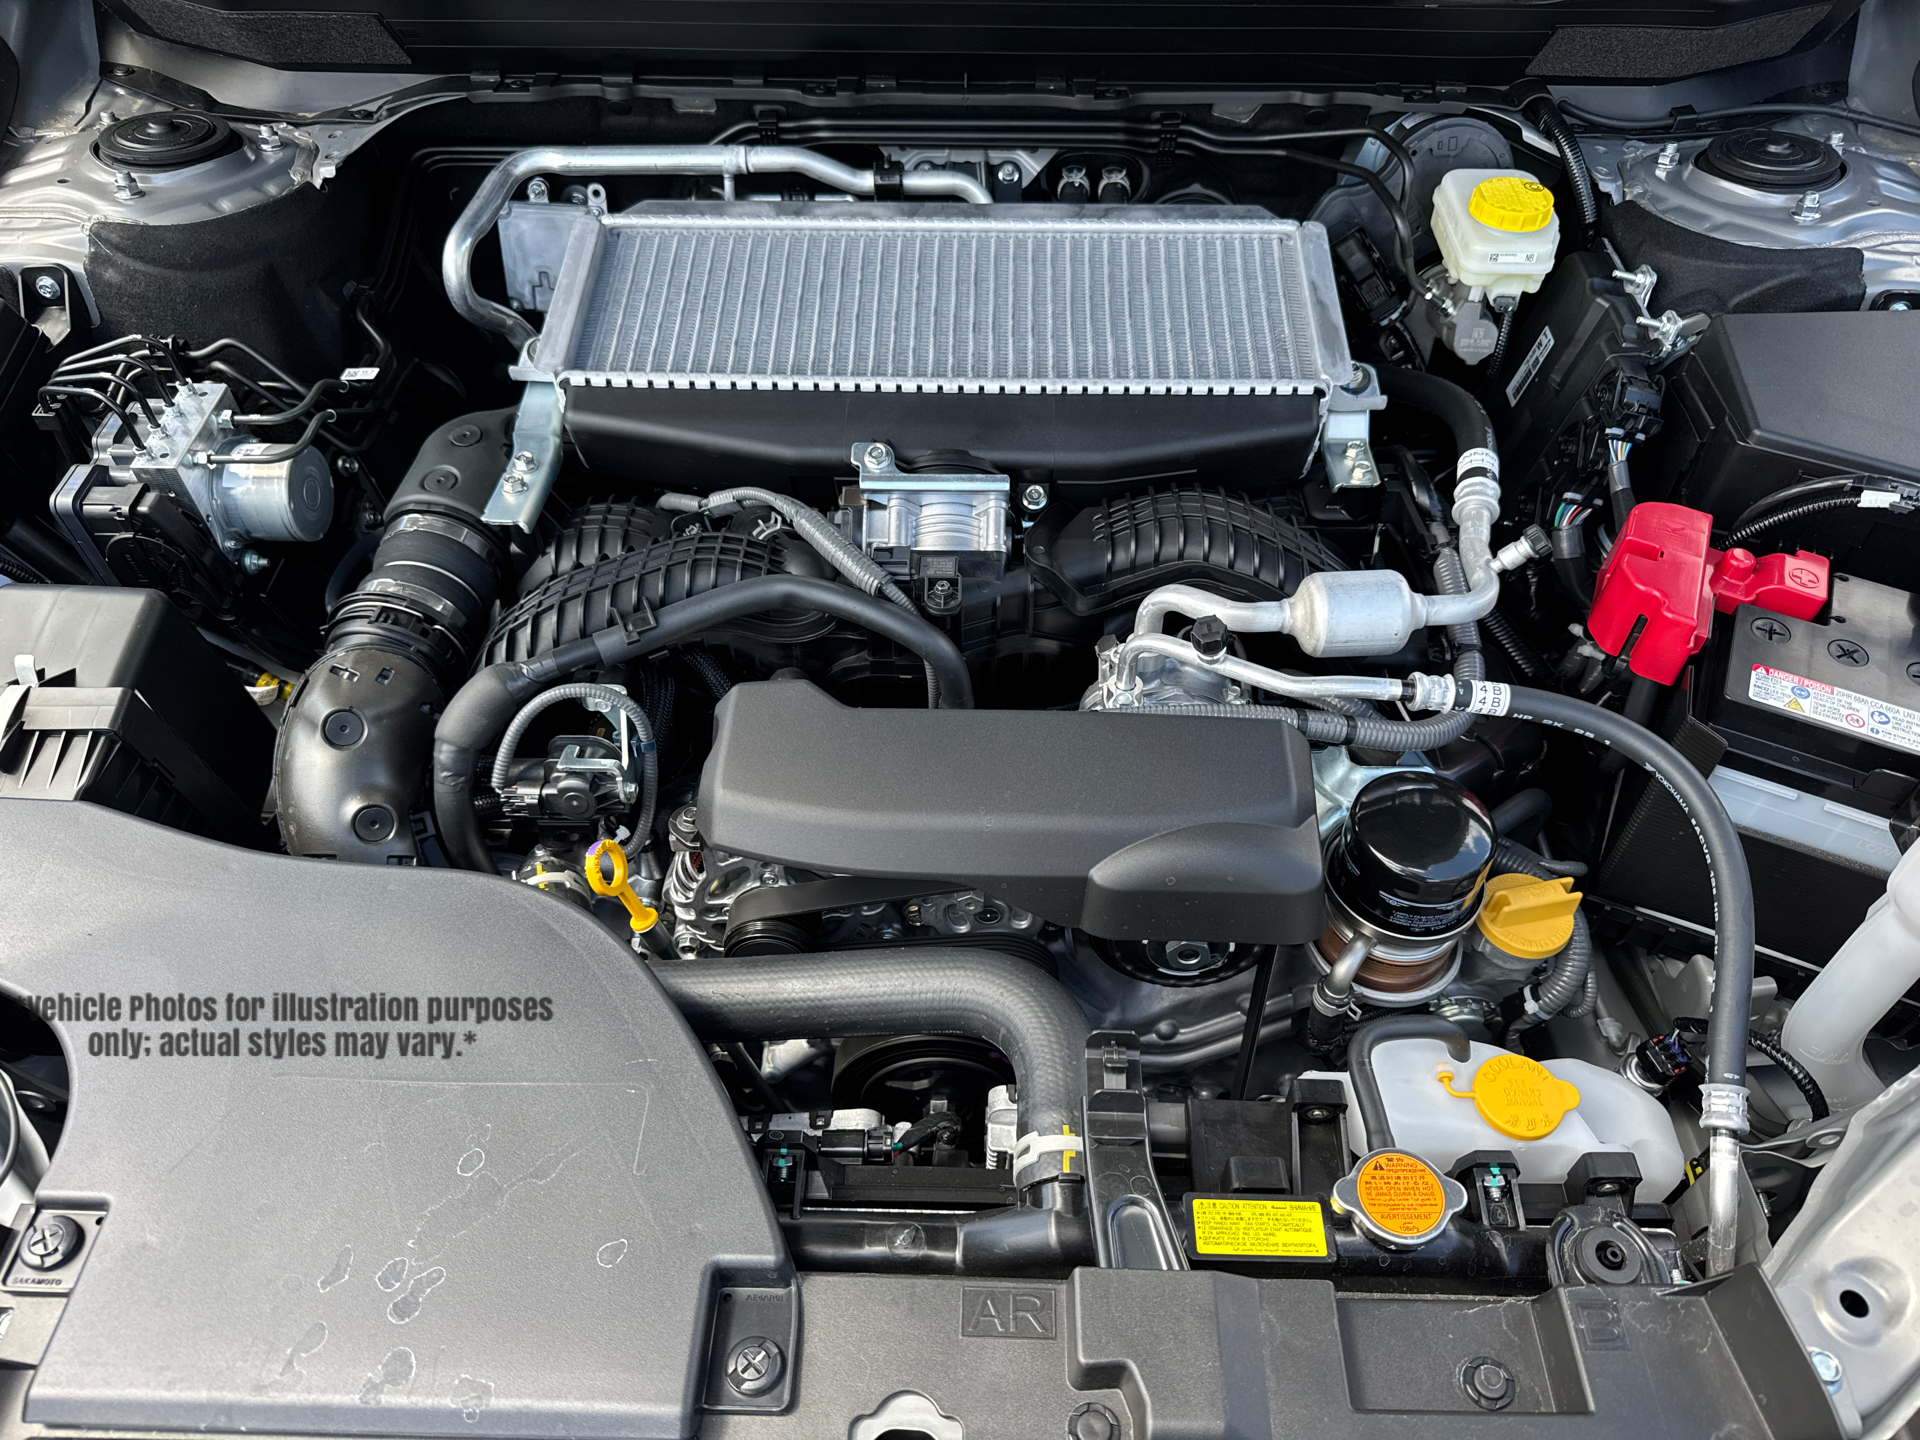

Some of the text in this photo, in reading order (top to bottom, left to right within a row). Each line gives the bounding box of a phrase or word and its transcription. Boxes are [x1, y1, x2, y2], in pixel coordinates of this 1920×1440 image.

[1769, 668, 1799, 684] DANGER
[1804, 680, 1833, 694] POISON
[1870, 700, 1884, 711] CCA
[1655, 771, 1689, 814] YOKOHAMA
[1855, 840, 1900, 860] LOWE
[1482, 1056, 1554, 1083] COOLANT
[1219, 1202, 1240, 1210] CAUTION
[11, 1277, 63, 1286] SAKAMOTO
[969, 1290, 1048, 1333] AR
